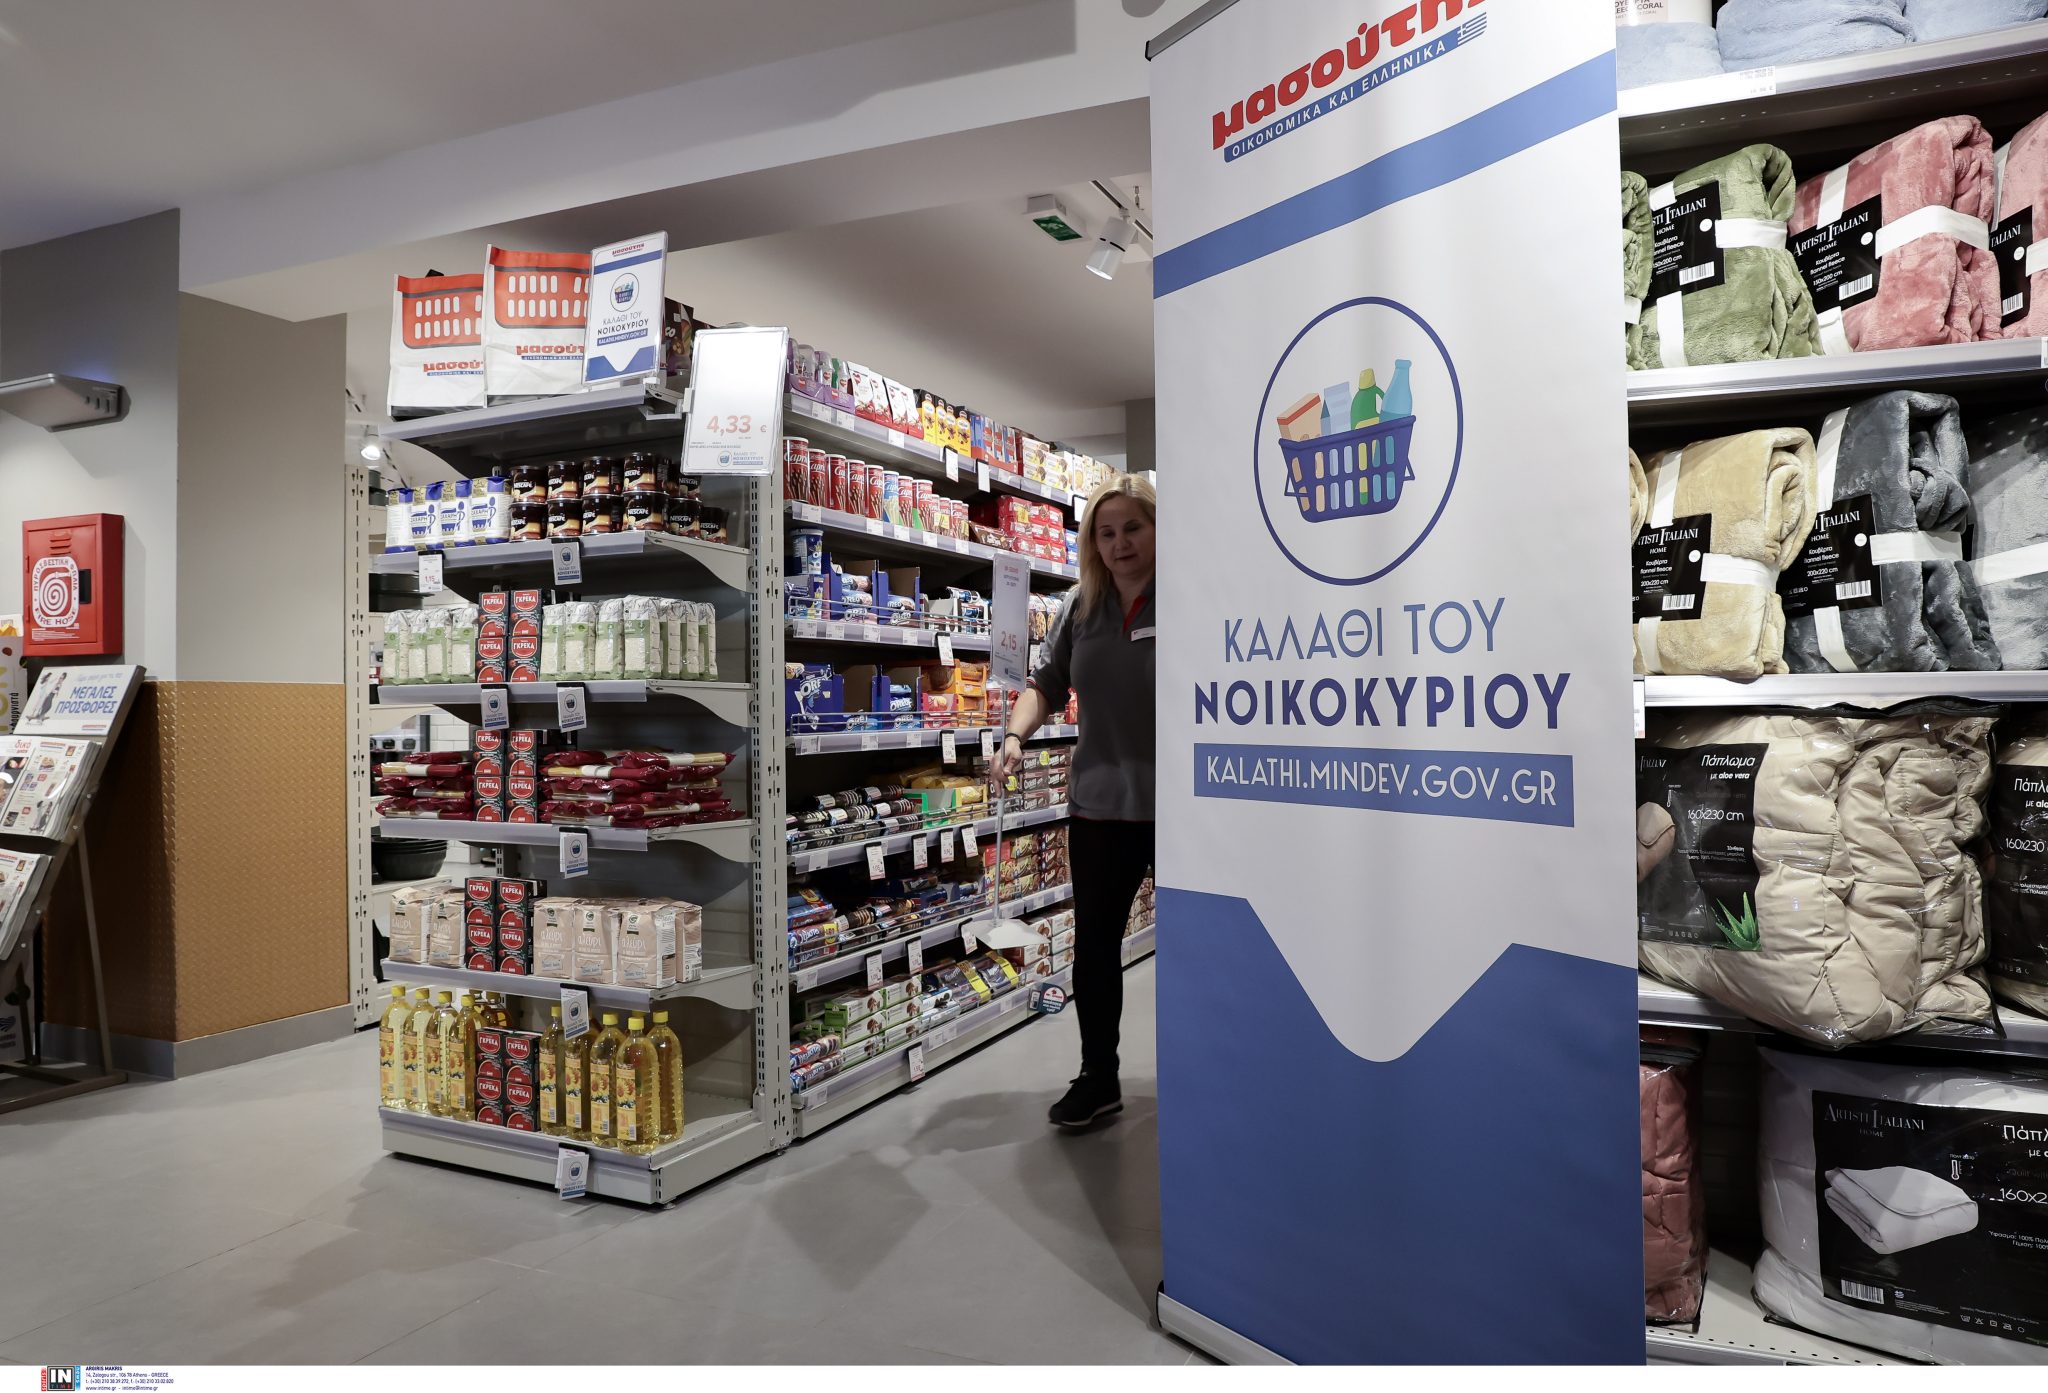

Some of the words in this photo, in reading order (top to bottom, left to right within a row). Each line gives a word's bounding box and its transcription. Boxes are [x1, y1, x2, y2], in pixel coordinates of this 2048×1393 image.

[1637, 2, 1664, 10] CORAL
[1231, 105, 1322, 158] ΟΙΚΟΝΟΜΙΚΑ
[1329, 85, 1355, 109] ΚΑΙ
[1361, 40, 1446, 90] ΕΛΛΗΝΙΚΑ
[1664, 198, 1707, 226] ITALIANI
[1656, 224, 1675, 235] HOME
[1793, 231, 1828, 257] ARTISTI
[1827, 211, 1869, 242] ITALIANI
[1991, 224, 2021, 248] TALIANI
[1818, 240, 1837, 253] HOME
[1653, 257, 1673, 268] 50x200
[706, 415, 752, 437] 4,33
[1819, 510, 1860, 532] ITALIANI
[1659, 528, 1698, 546] ITALIANI
[1811, 533, 1830, 542] HOME
[1224, 607, 1383, 663] ΚΑΛΑΘΙ
[1403, 597, 1505, 655] ΤΟΥ
[1000, 630, 1017, 651] 2,15
[70, 686, 117, 699] ΜΕΓΑΛΕΣ
[54, 700, 118, 714] ΠΡΟΣΦΟΡΕΣ
[1195, 673, 1571, 730] ΝΟΙΚΟΚΥΡΙΟΥ
[1701, 754, 1756, 769] Πάπλωμα
[1207, 755, 1557, 806] KALATHI.MINDEV.GOV.GR
[1718, 772, 1733, 780] aloe
[1734, 772, 1750, 780] vera
[2026, 800, 2034, 808] με
[1687, 809, 1724, 820] 160x230
[1726, 811, 1744, 821] cm
[2005, 837, 2045, 853] 160x230
[1824, 1104, 1869, 1123] ARTISTI
[1872, 1110, 1925, 1130] ITALIANI
[2028, 1149, 2041, 1158] με
